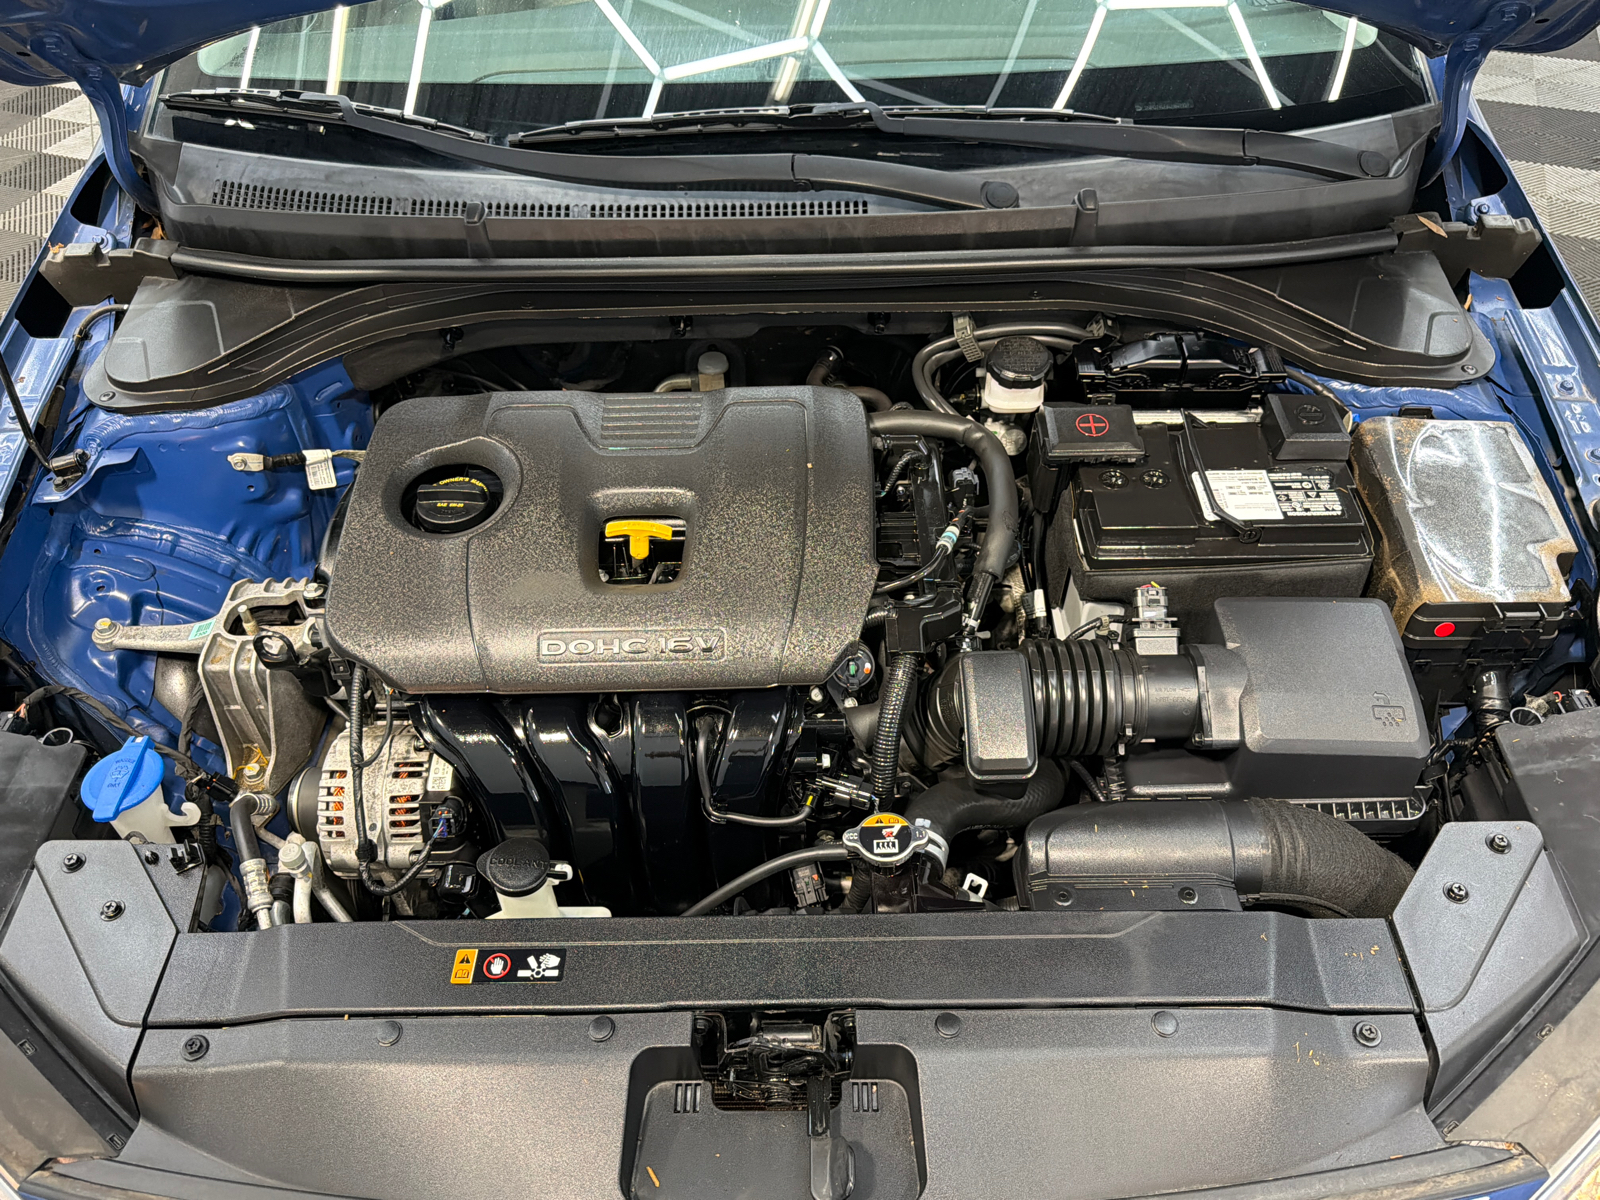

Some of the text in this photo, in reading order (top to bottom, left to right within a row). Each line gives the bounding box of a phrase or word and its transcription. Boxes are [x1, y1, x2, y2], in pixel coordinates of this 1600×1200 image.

[541, 636, 721, 656] DOHC 16V
[915, 830, 926, 838] 1.1
[490, 858, 549, 870] COOLANT
